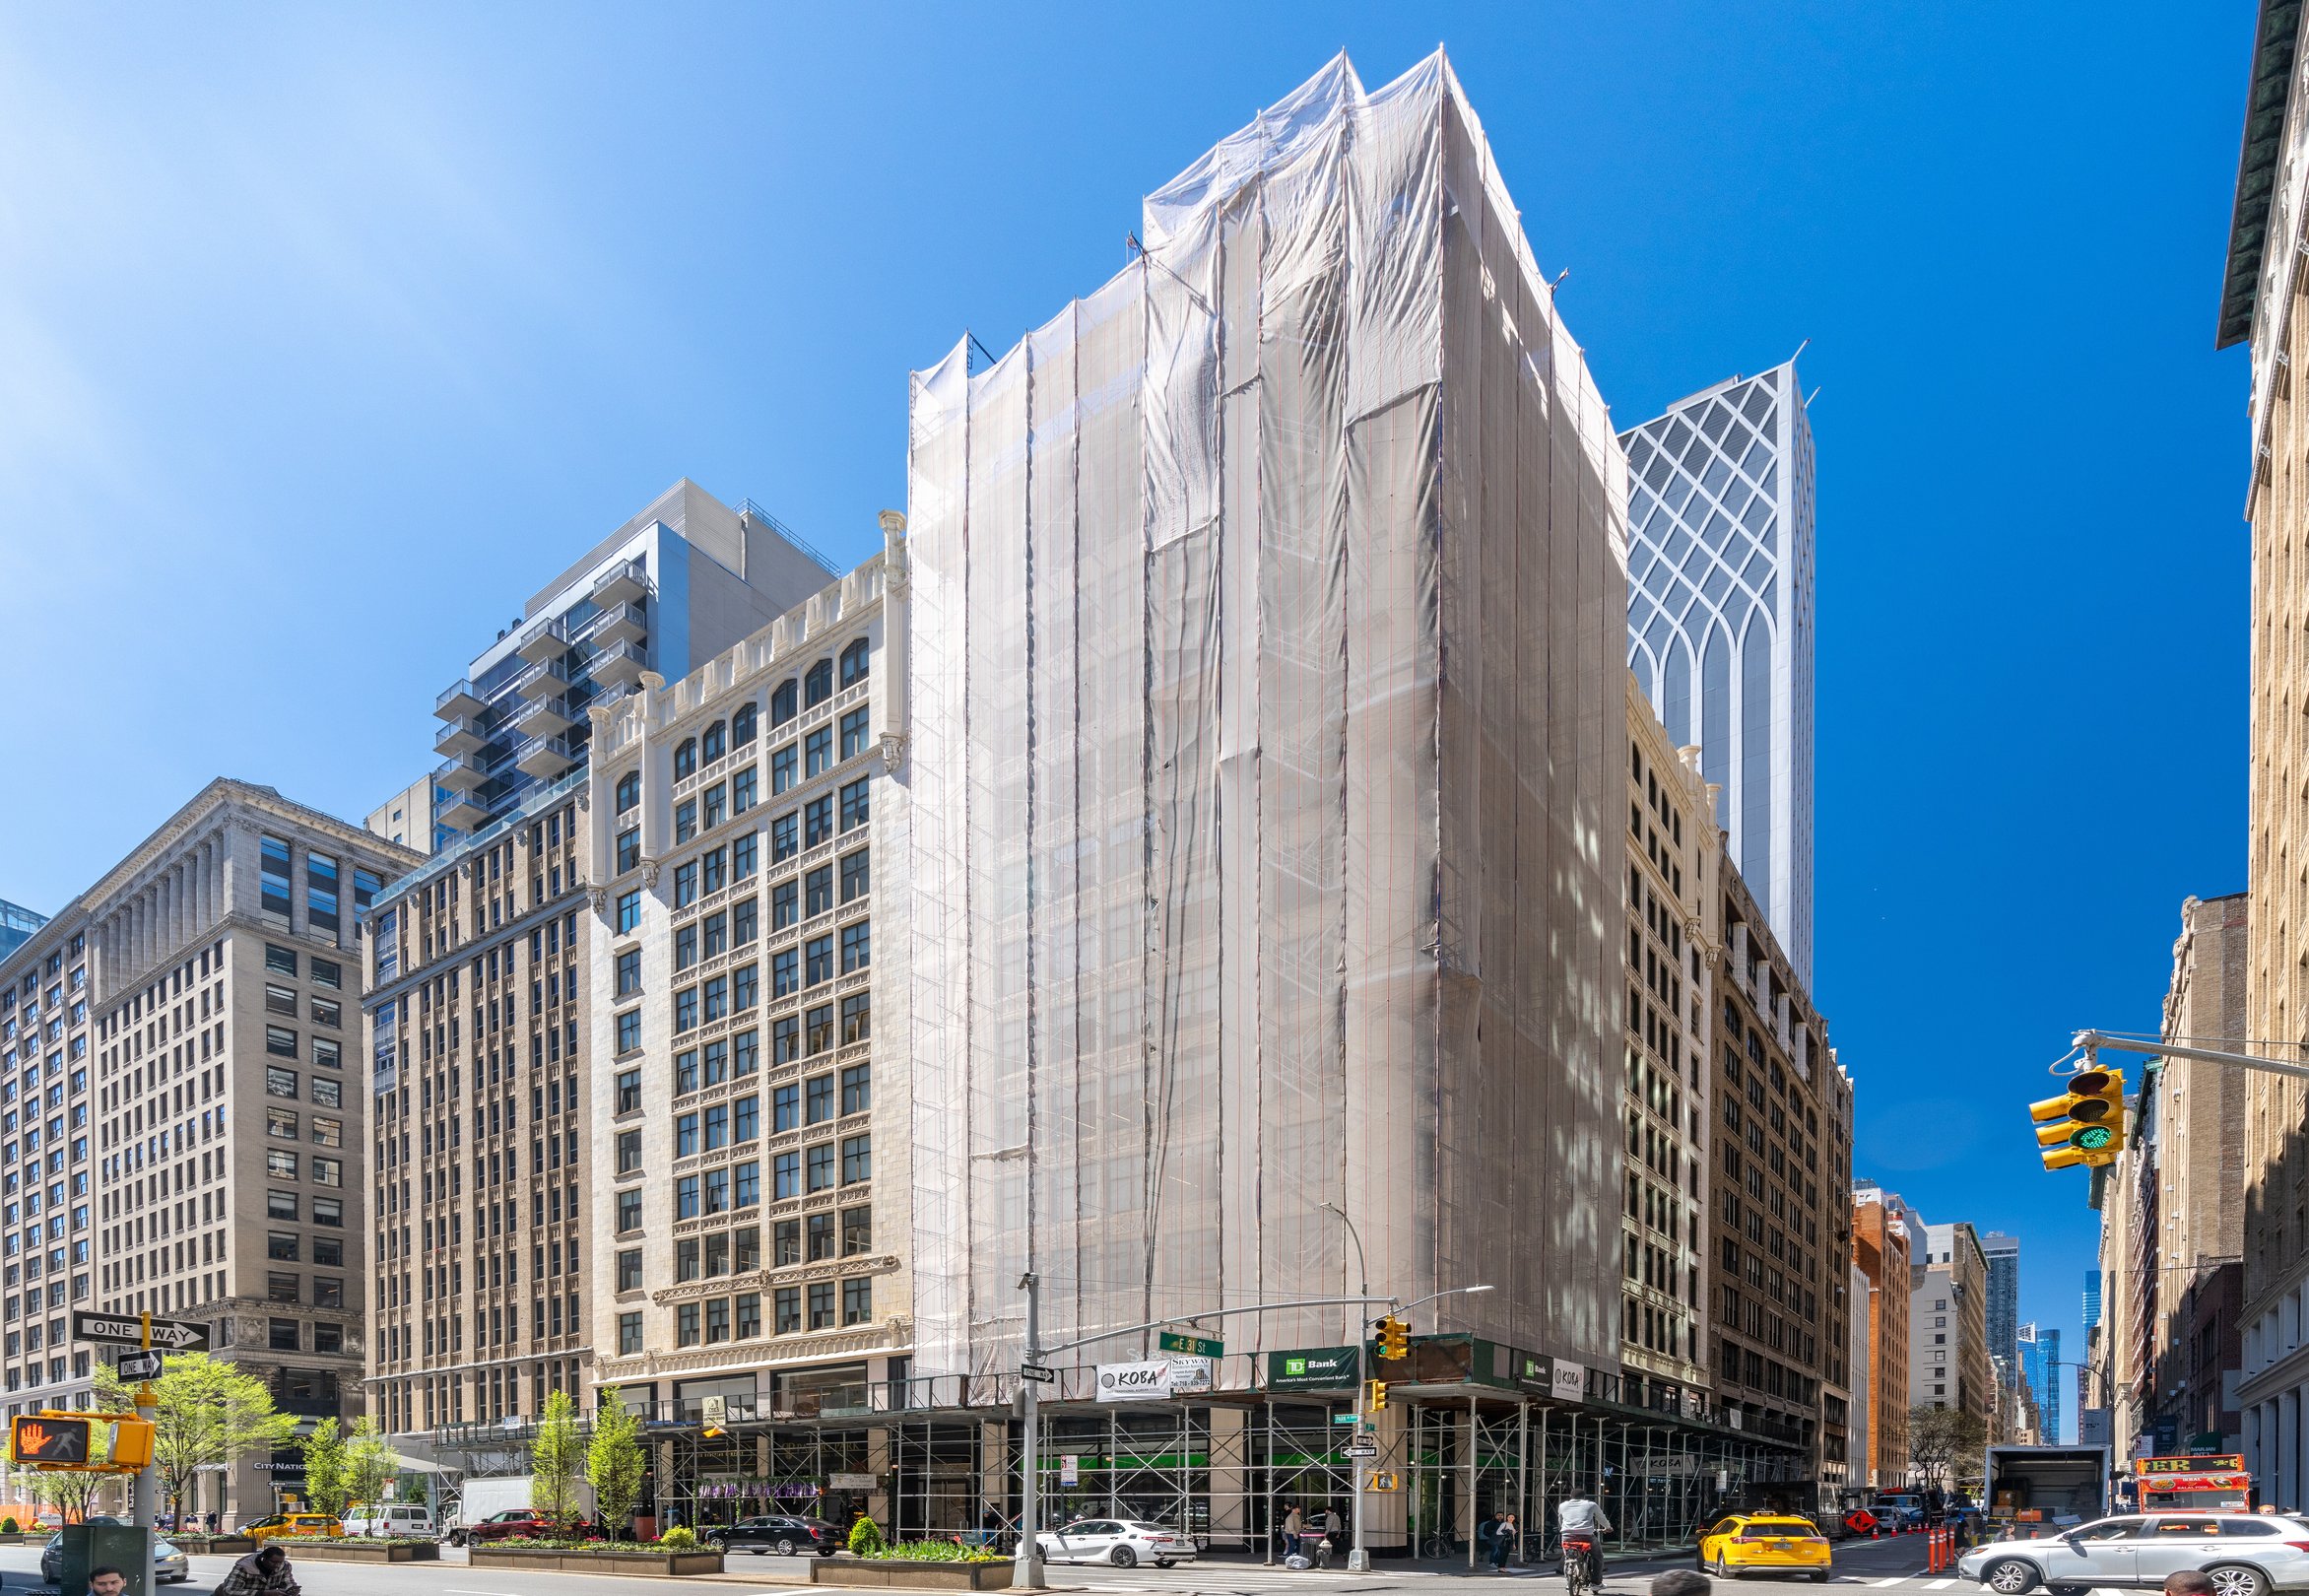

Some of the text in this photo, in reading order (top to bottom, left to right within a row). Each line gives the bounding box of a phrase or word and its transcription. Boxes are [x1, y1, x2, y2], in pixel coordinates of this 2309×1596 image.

[94, 1322, 190, 1342] ONE WAY
[1178, 1338, 1206, 1354] E 31 St
[123, 1359, 156, 1374] ONE WAY
[1288, 1360, 1338, 1371] TD Bank
[1534, 1364, 1547, 1374] Bank
[1118, 1370, 1157, 1386] KOBA
[1562, 1370, 1579, 1389] KOBA
[1650, 1459, 1681, 1468] KOBA
